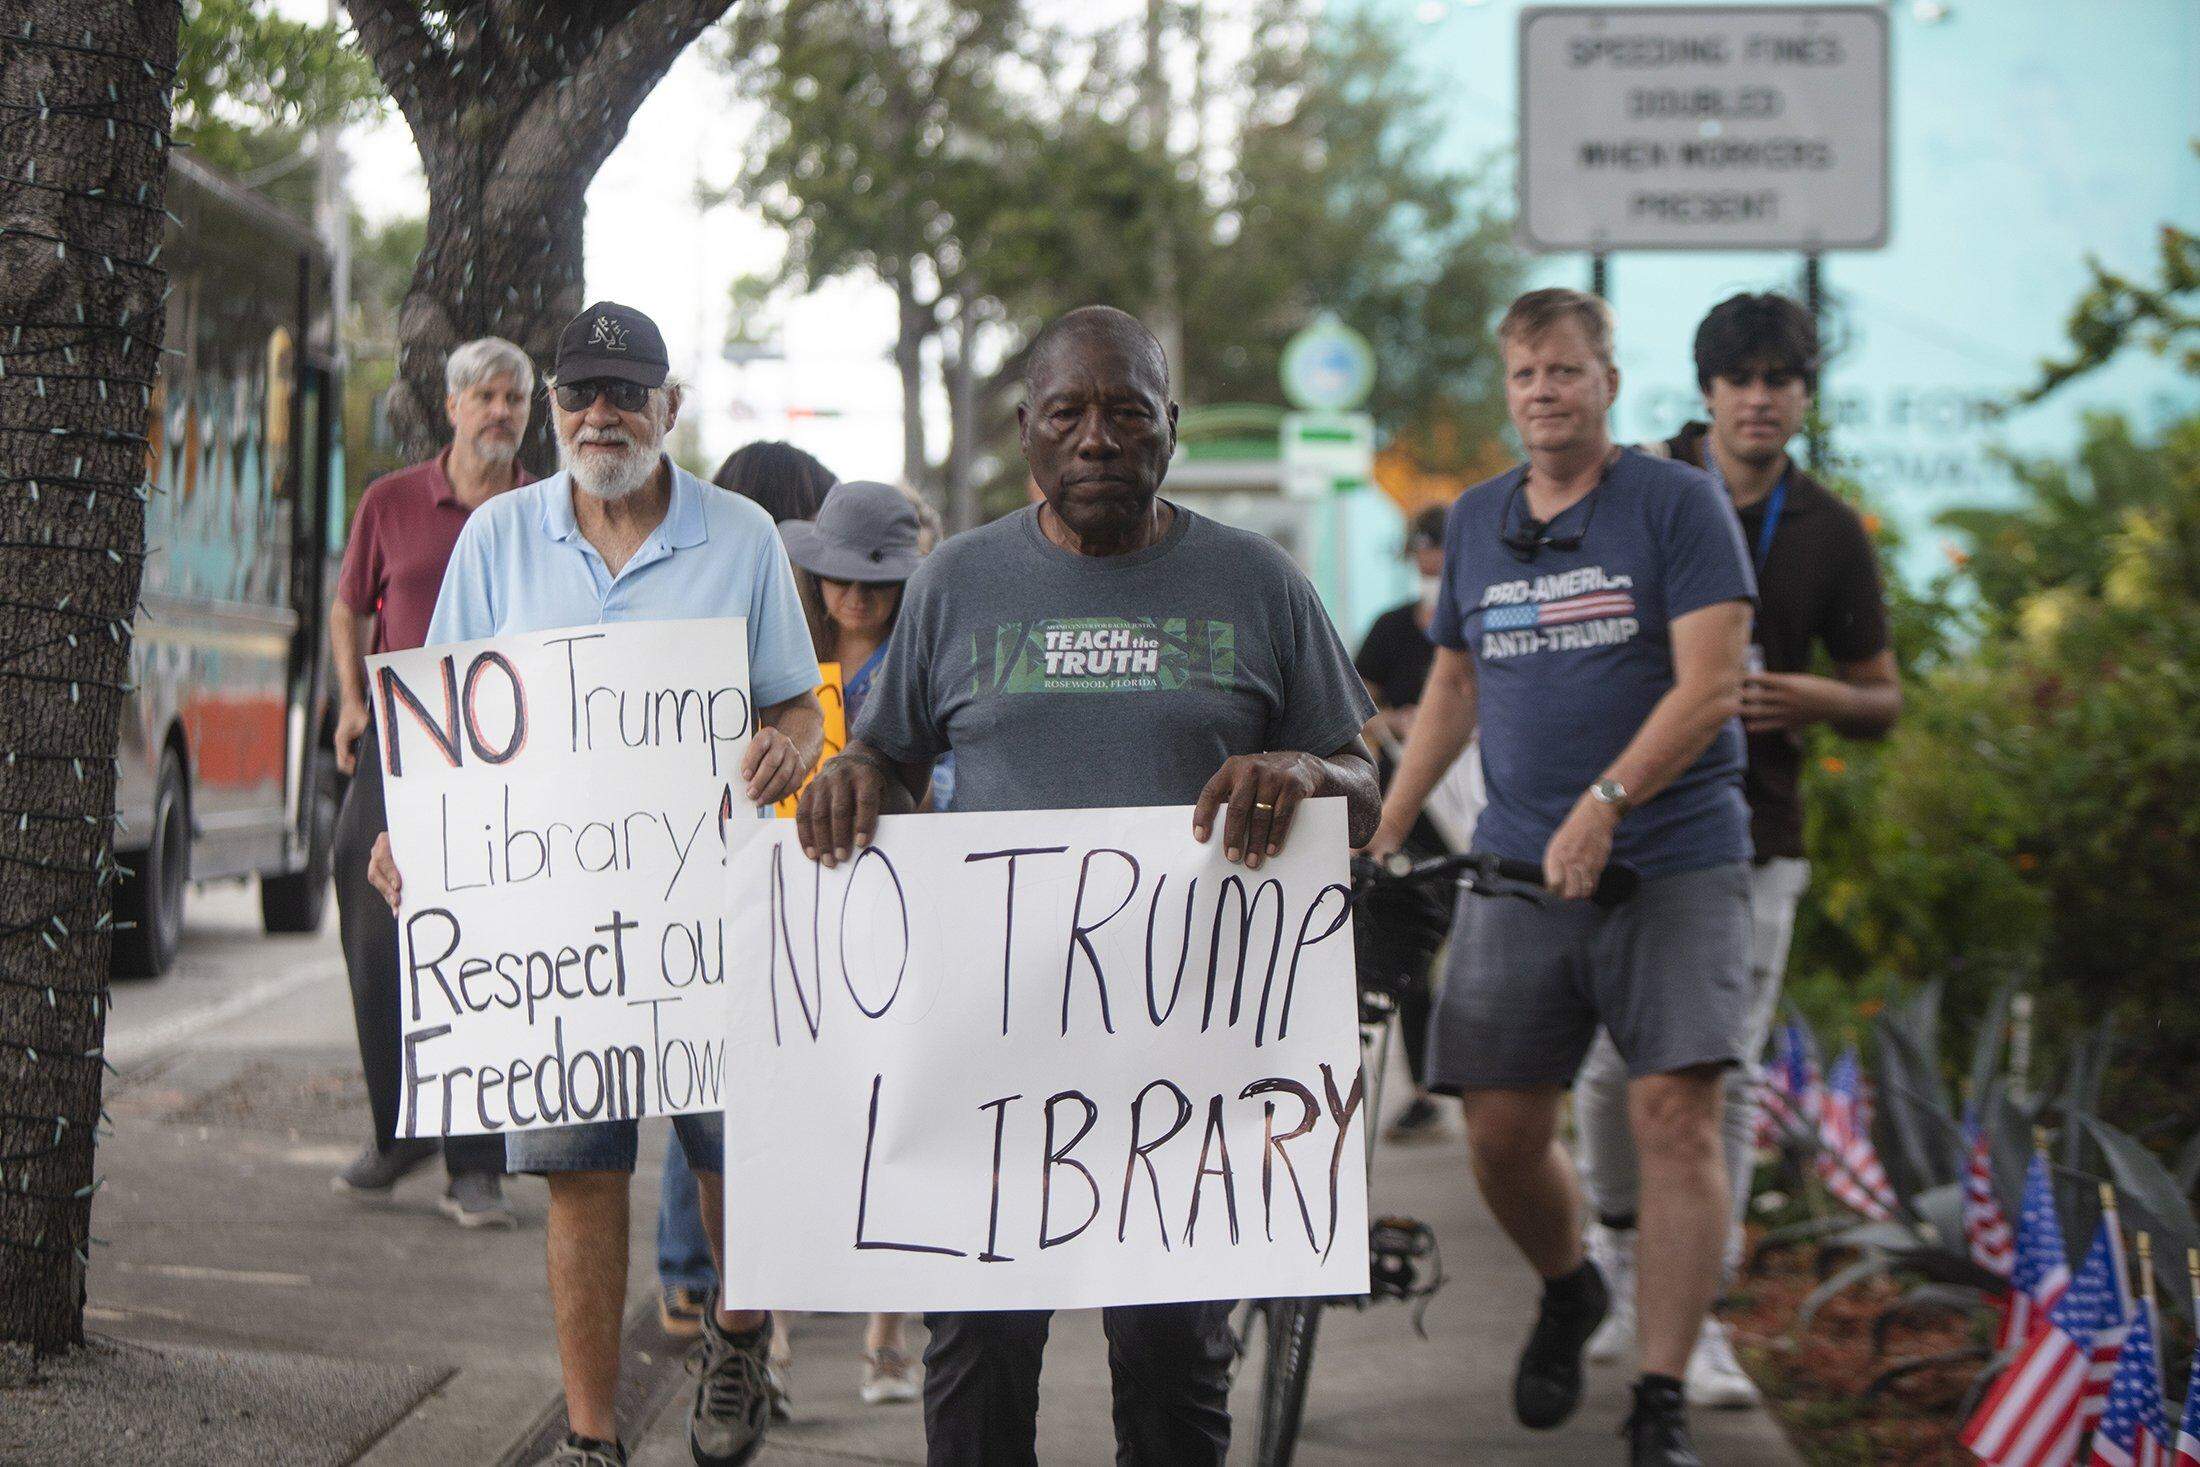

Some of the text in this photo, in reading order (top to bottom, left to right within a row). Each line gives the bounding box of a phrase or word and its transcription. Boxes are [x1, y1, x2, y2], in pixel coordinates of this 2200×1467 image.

[1571, 35, 1840, 67] SPEEDING FINES
[1631, 88, 1780, 119] DOUBLED
[1580, 141, 1832, 170] WHEN WORKERS
[1630, 192, 1776, 222] PRESENT
[1045, 630, 1159, 650] TEACH the
[1481, 617, 1640, 660] ANTI-TRUMP
[1045, 649, 1159, 675] TRUTH
[1044, 678, 1158, 689] ROSEWOOD, FLORIDA
[377, 650, 528, 777] NO
[543, 633, 748, 776] Trump
[442, 781, 733, 901] Library!
[770, 842, 1354, 1048] NO TRUMP
[407, 907, 725, 1025] Respect ou
[404, 1015, 646, 1139] Freedom
[854, 1062, 1364, 1267] LIBRARY
